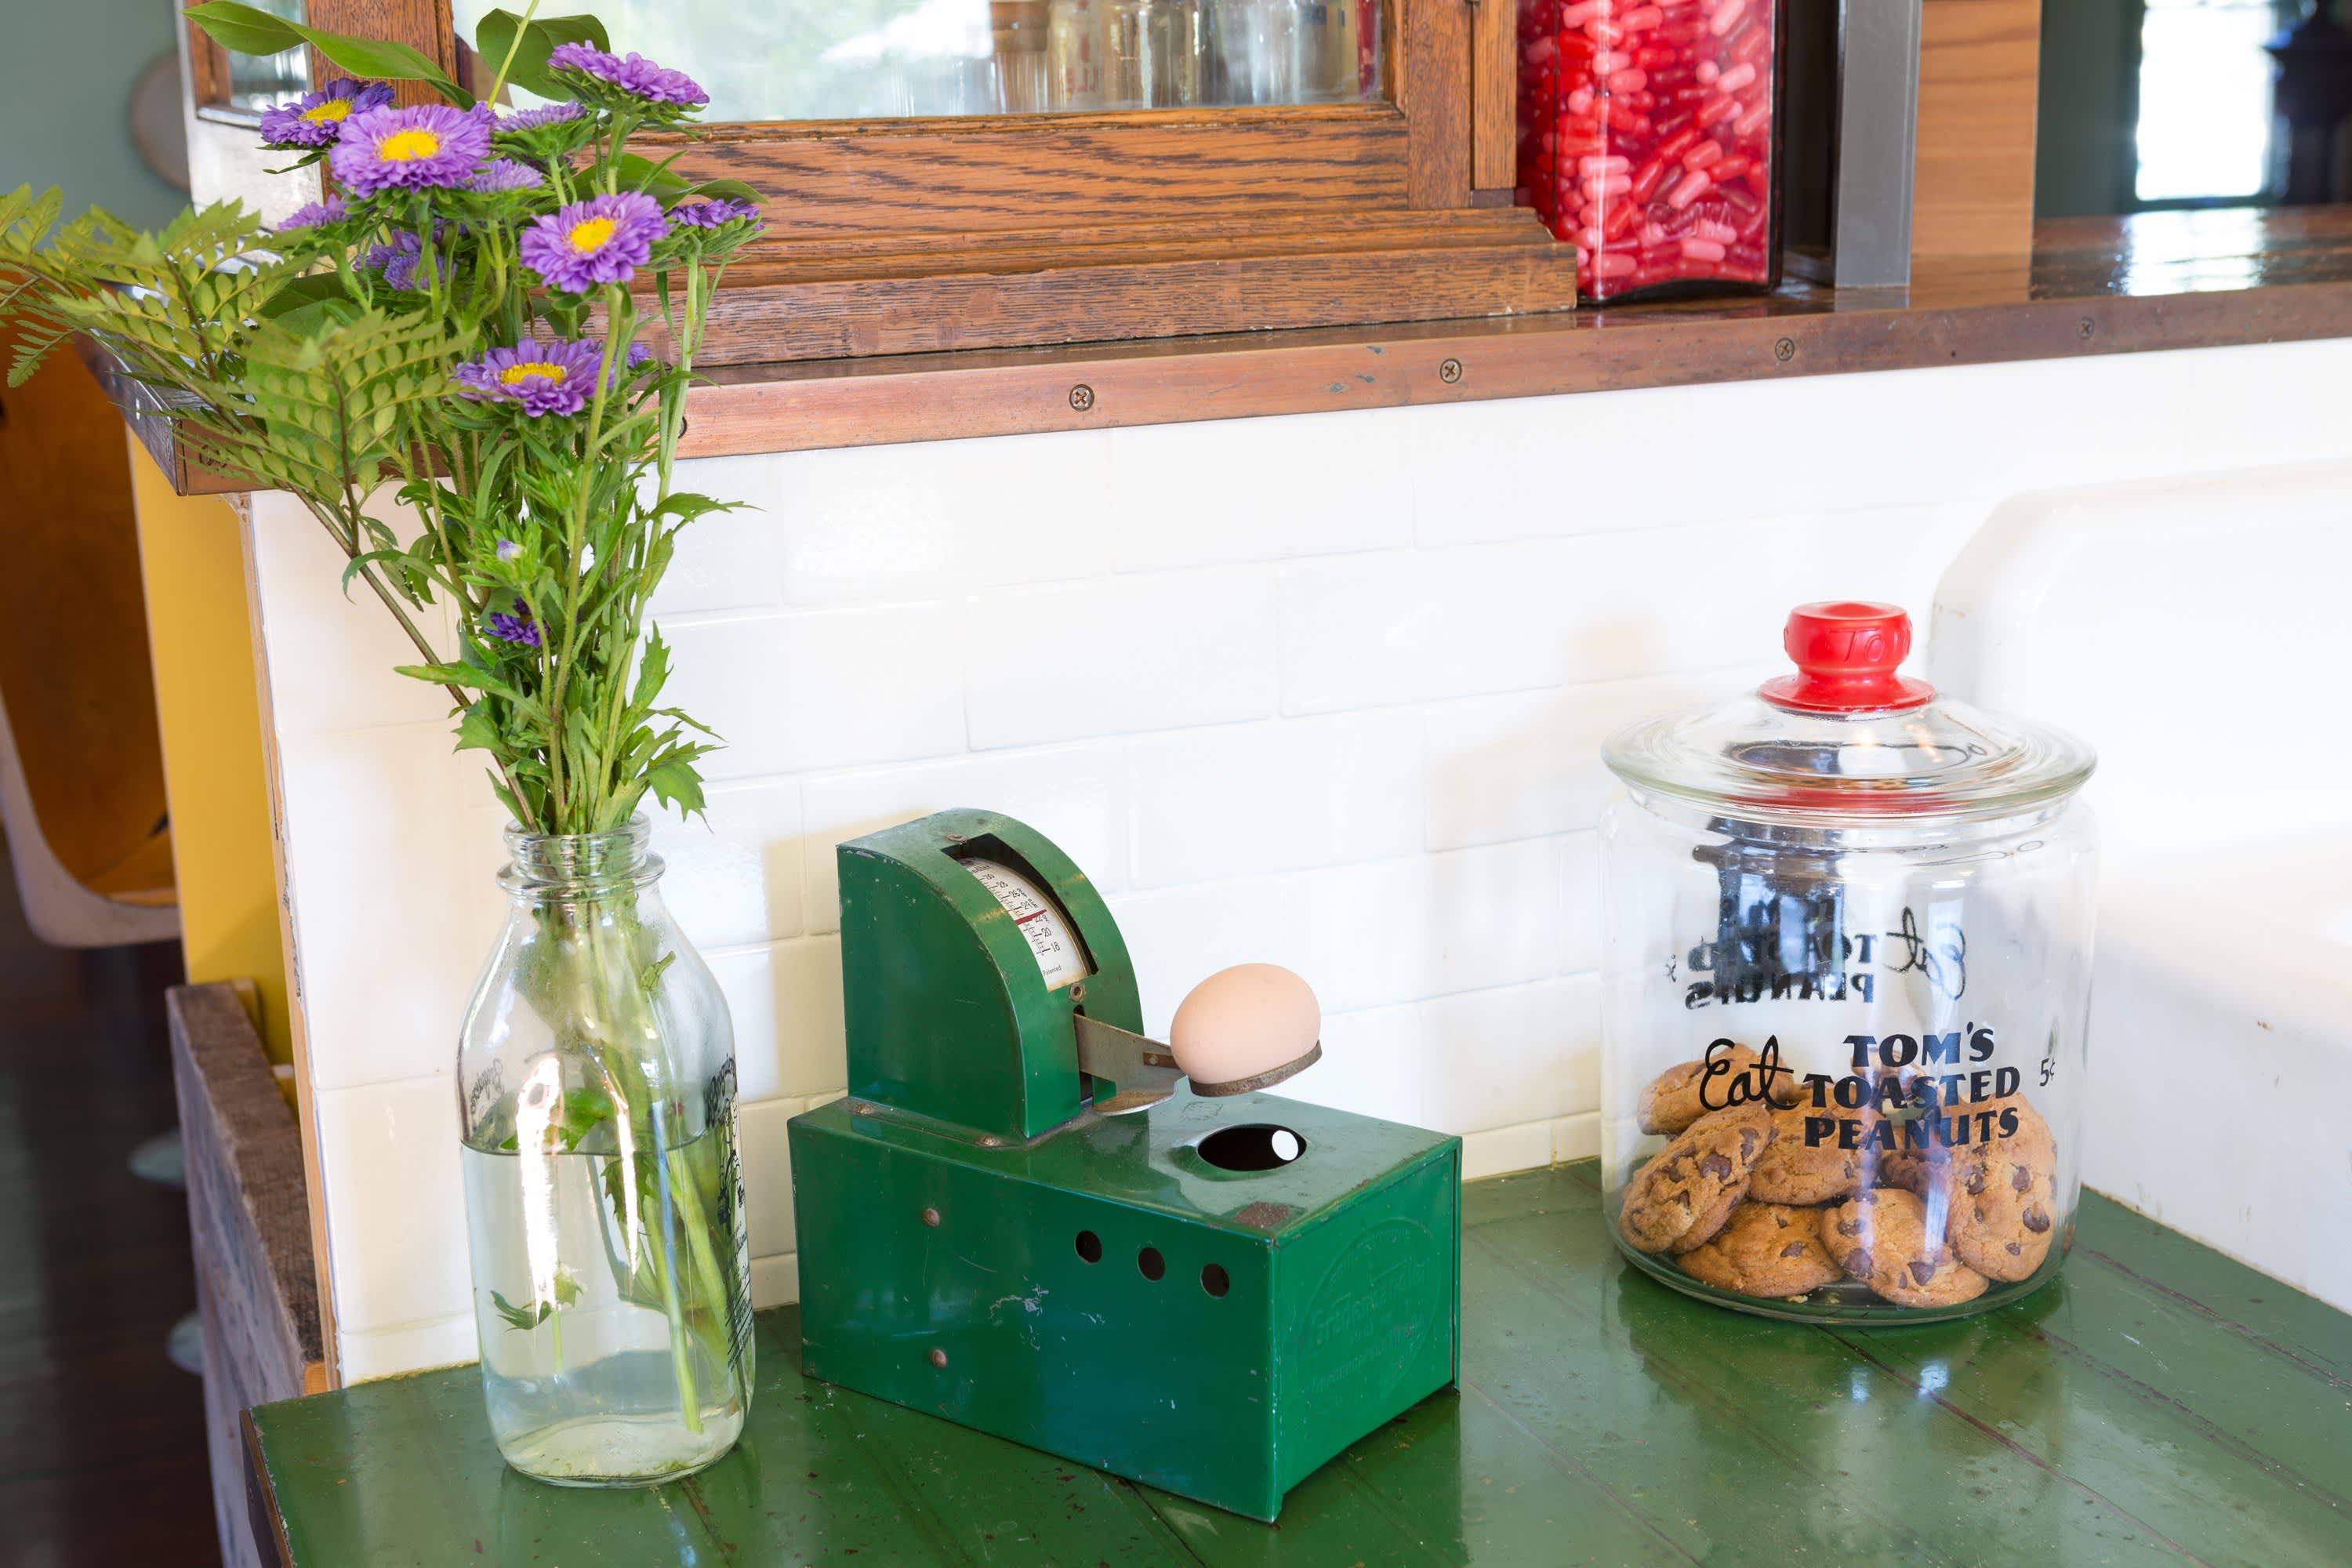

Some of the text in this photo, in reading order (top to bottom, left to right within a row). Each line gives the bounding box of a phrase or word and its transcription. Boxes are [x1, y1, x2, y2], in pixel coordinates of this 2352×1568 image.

[1041, 927, 1052, 939] 20
[1051, 942, 1061, 953] 18
[1042, 964, 1062, 976] Patented
[1843, 1021, 1994, 1068] TOM'S
[1699, 1034, 2055, 1112] Eat TOASTED 5¢
[1804, 1106, 2020, 1151] PEANUTS
